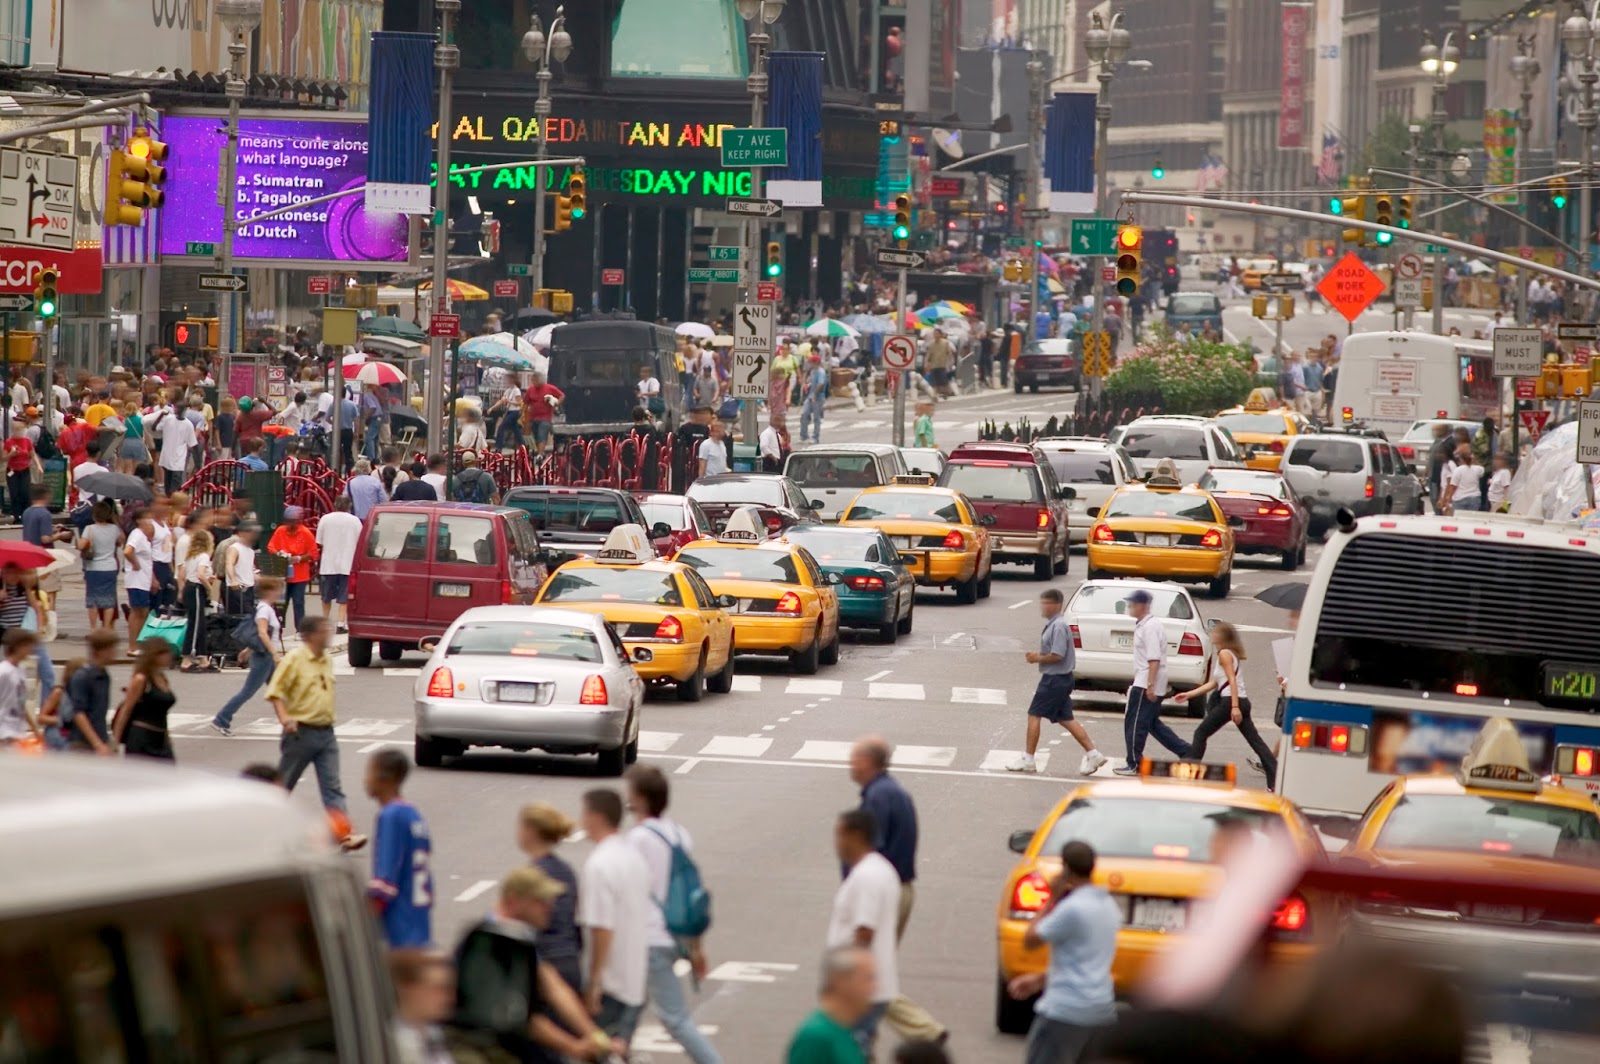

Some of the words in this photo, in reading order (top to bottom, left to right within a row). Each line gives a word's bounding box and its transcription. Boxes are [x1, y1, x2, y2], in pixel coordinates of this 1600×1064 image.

[452, 116, 493, 141] AL
[240, 137, 284, 149] means
[738, 135, 744, 146] 7
[751, 135, 771, 146] AVE
[728, 150, 750, 159] KEEP
[754, 149, 780, 159] RIGHT
[25, 156, 40, 171] OK
[243, 151, 276, 165] what
[280, 152, 349, 169] language?
[237, 175, 250, 187] a.
[253, 174, 323, 188] Sumatran
[703, 171, 752, 196] NIG
[54, 188, 69, 203] OK
[237, 190, 250, 203] b.
[734, 202, 749, 211] ONE
[760, 204, 776, 212] WAY
[236, 208, 248, 220] c.
[51, 216, 68, 230] NO
[237, 225, 251, 237] d.
[253, 225, 297, 238] Dutch
[187, 243, 193, 254] W
[194, 243, 204, 254] 45
[710, 248, 716, 259] W
[719, 248, 728, 259] 45
[883, 253, 896, 261] ONE
[906, 256, 920, 264] WAY
[690, 270, 712, 278] GEORGE
[715, 270, 737, 278] ABBOTT
[1336, 268, 1365, 278] ROAD
[1336, 281, 1365, 291] WORK
[1403, 283, 1415, 291] NO
[12, 298, 27, 306] WAY
[1335, 294, 1365, 304] AHEAD
[1398, 292, 1420, 301] TURNS
[751, 307, 769, 319] NO
[739, 336, 767, 346] TURN
[1496, 334, 1518, 342] RIGHT
[1521, 335, 1540, 343] LANE
[1505, 348, 1531, 357] MUST
[736, 354, 753, 366] NO
[1496, 363, 1515, 371] TURN
[1518, 363, 1540, 371] RIGHT
[737, 384, 765, 394] TURN
[1582, 409, 1600, 420] RIG
[1580, 446, 1600, 456] TUR
[1551, 671, 1596, 699] M20
